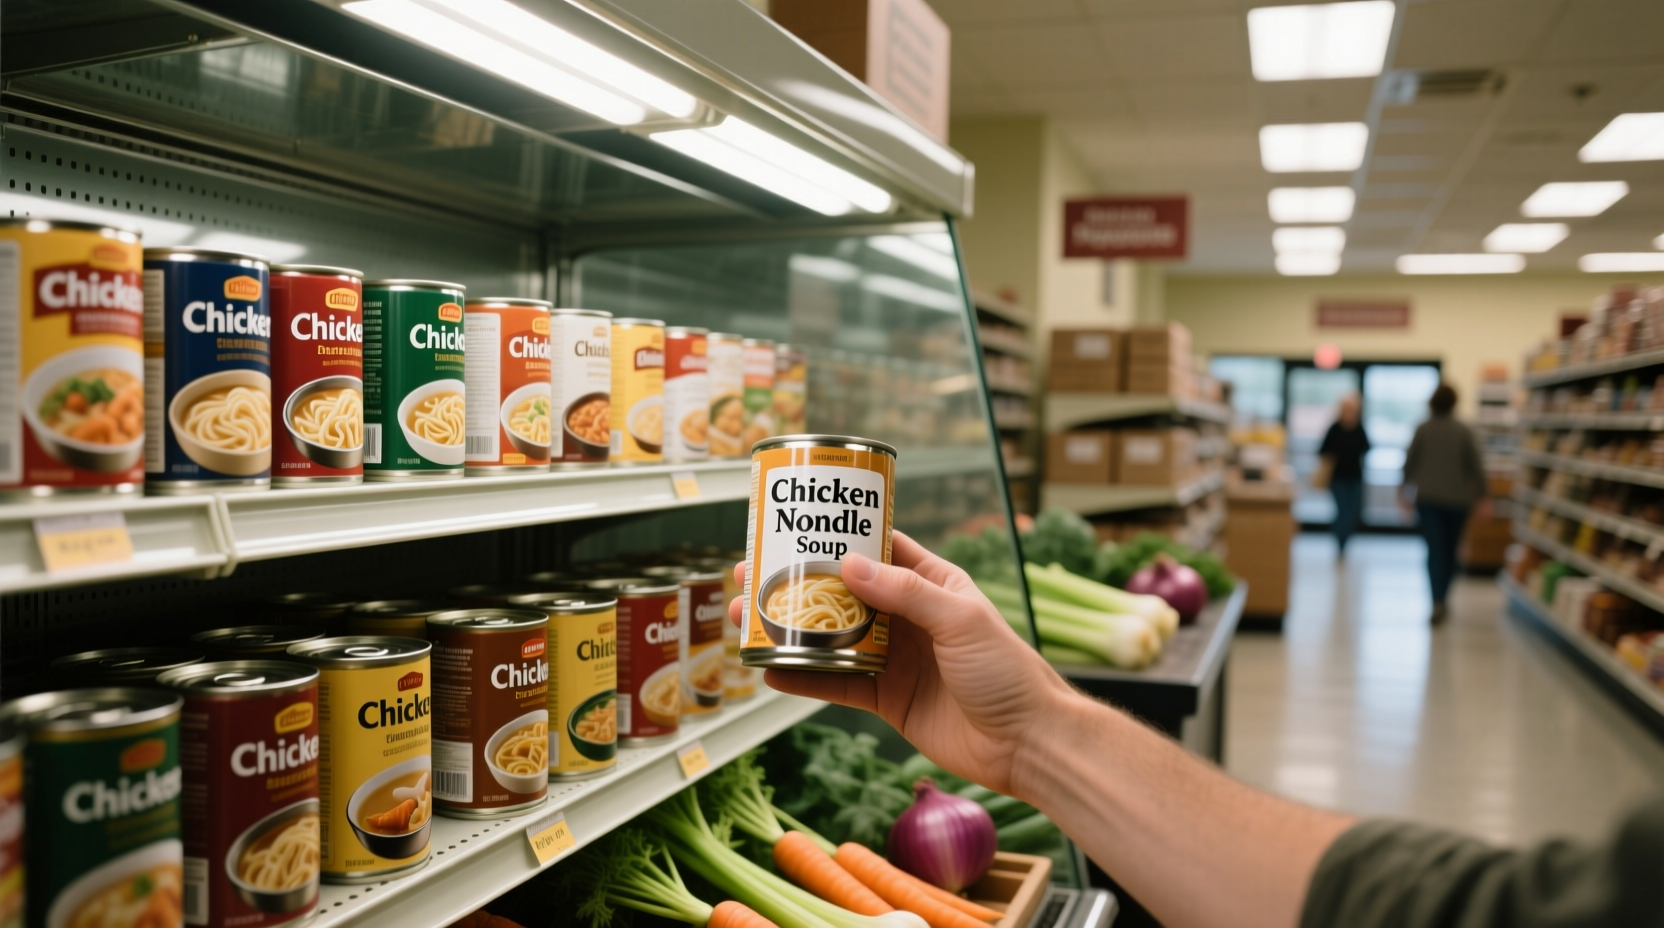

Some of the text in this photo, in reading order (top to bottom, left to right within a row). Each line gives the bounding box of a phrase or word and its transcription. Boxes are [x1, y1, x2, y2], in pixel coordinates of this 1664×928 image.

[771, 477, 879, 508] Chicken
[775, 508, 872, 537] Nondle
[796, 536, 848, 560] Soup
